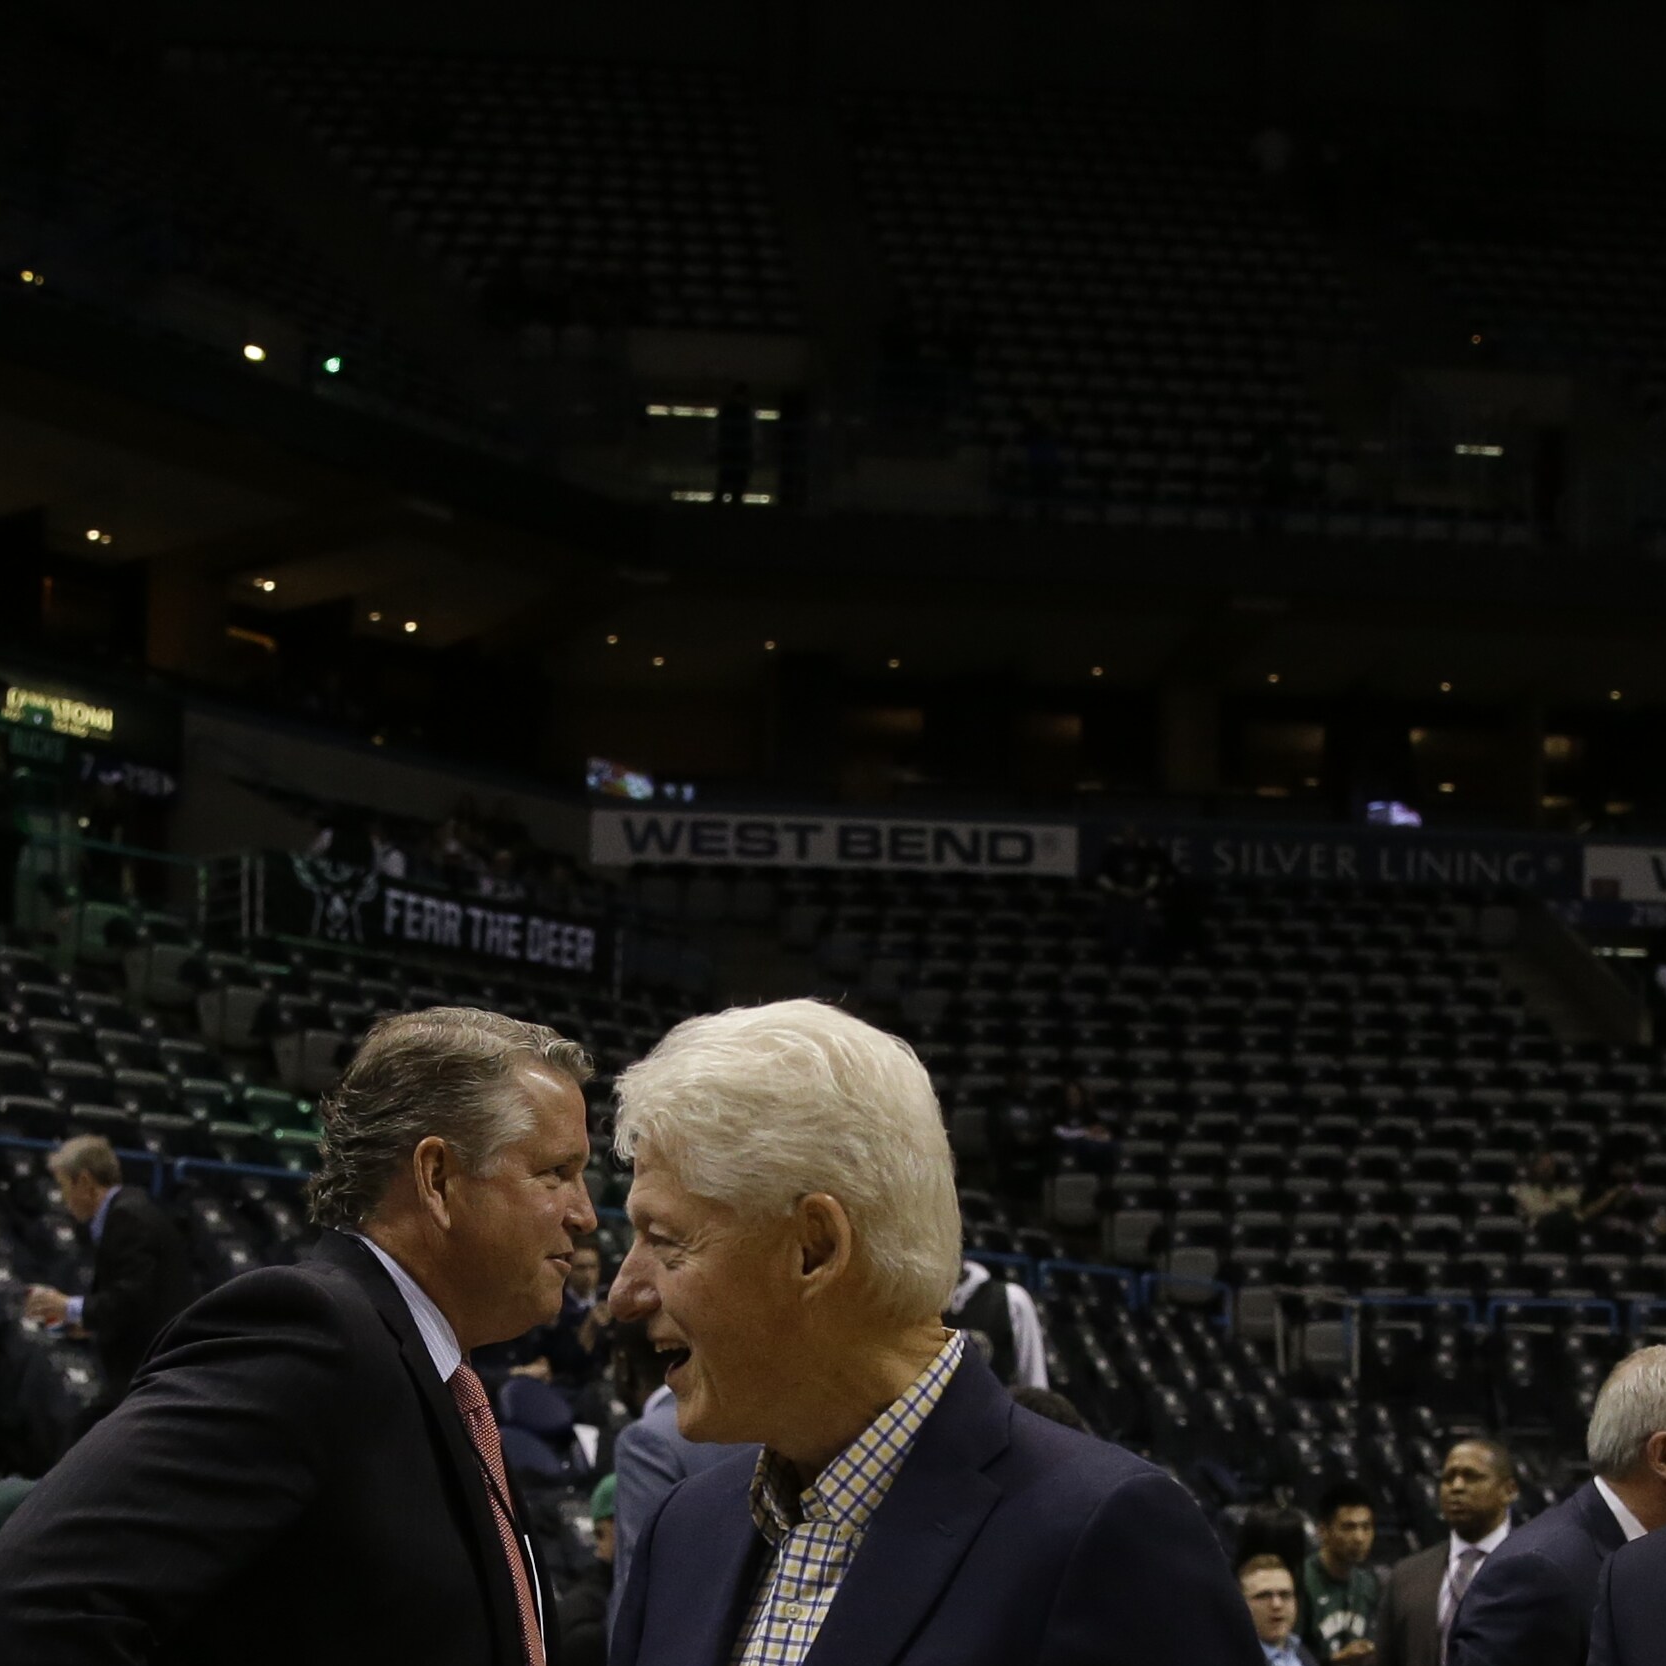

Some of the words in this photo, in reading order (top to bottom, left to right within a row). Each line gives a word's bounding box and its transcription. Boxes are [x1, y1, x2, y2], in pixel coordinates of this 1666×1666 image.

[622, 817, 822, 860] WEST
[837, 824, 1034, 867] BEND
[1212, 841, 1360, 882] SILVER
[1379, 846, 1537, 885] LINING
[383, 886, 463, 949] FEAR
[465, 905, 524, 961] THE
[525, 914, 596, 975] DEER
